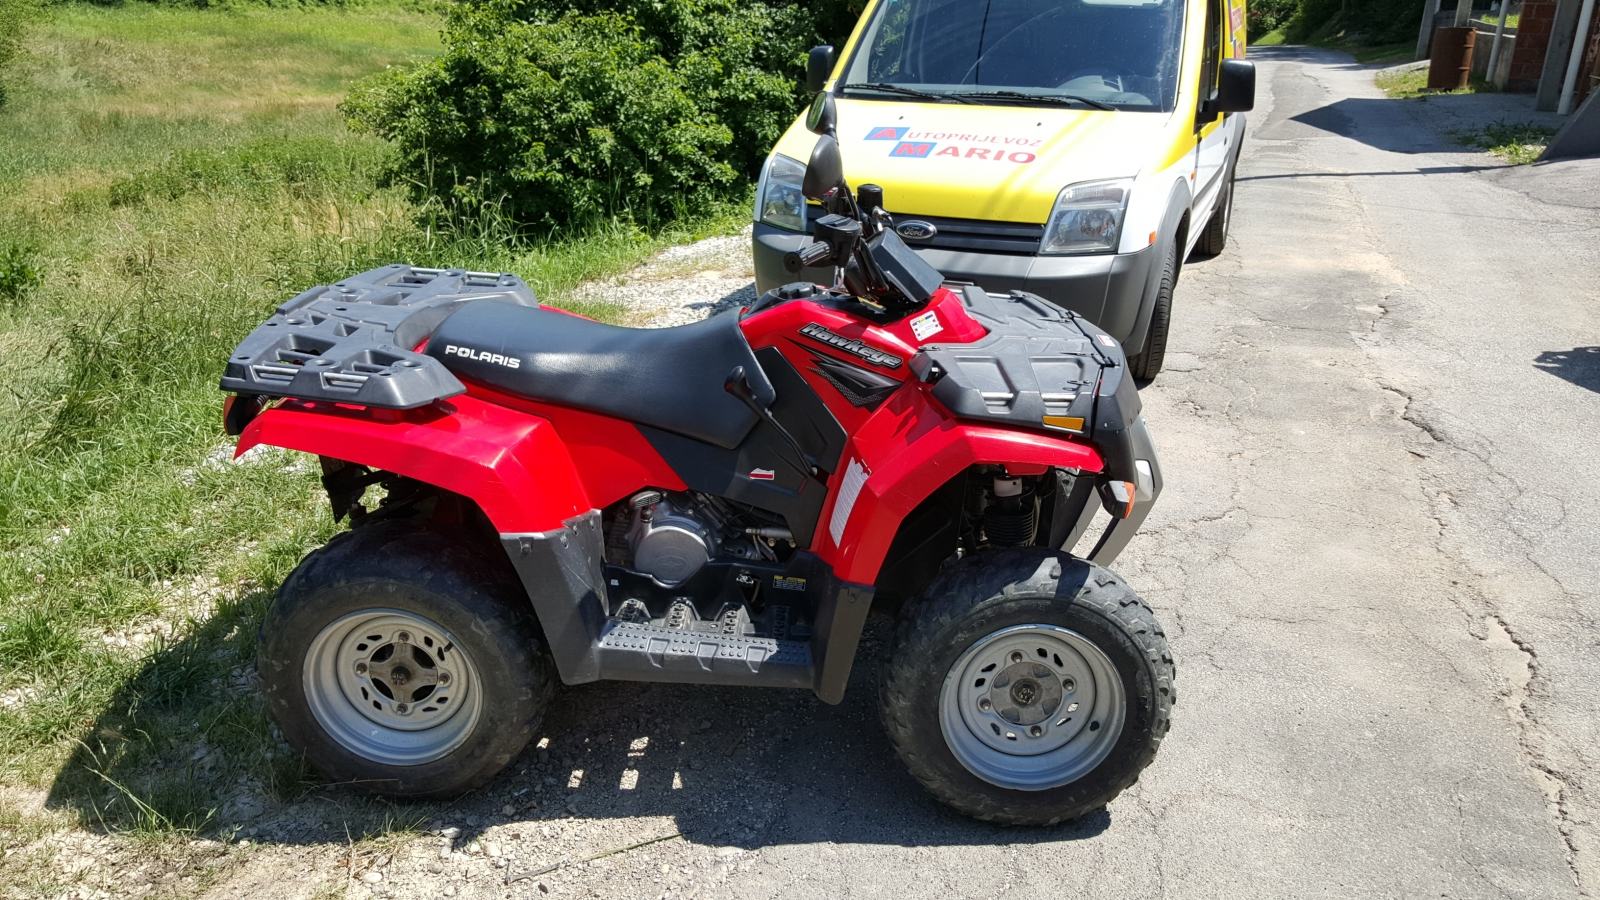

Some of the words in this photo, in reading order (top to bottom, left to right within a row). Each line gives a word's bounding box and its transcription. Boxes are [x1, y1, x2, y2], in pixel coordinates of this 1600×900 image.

[871, 127, 1042, 147] AUTOPRIJEVOZ
[895, 143, 1036, 164] MARIO
[445, 344, 521, 369] POLARIS
